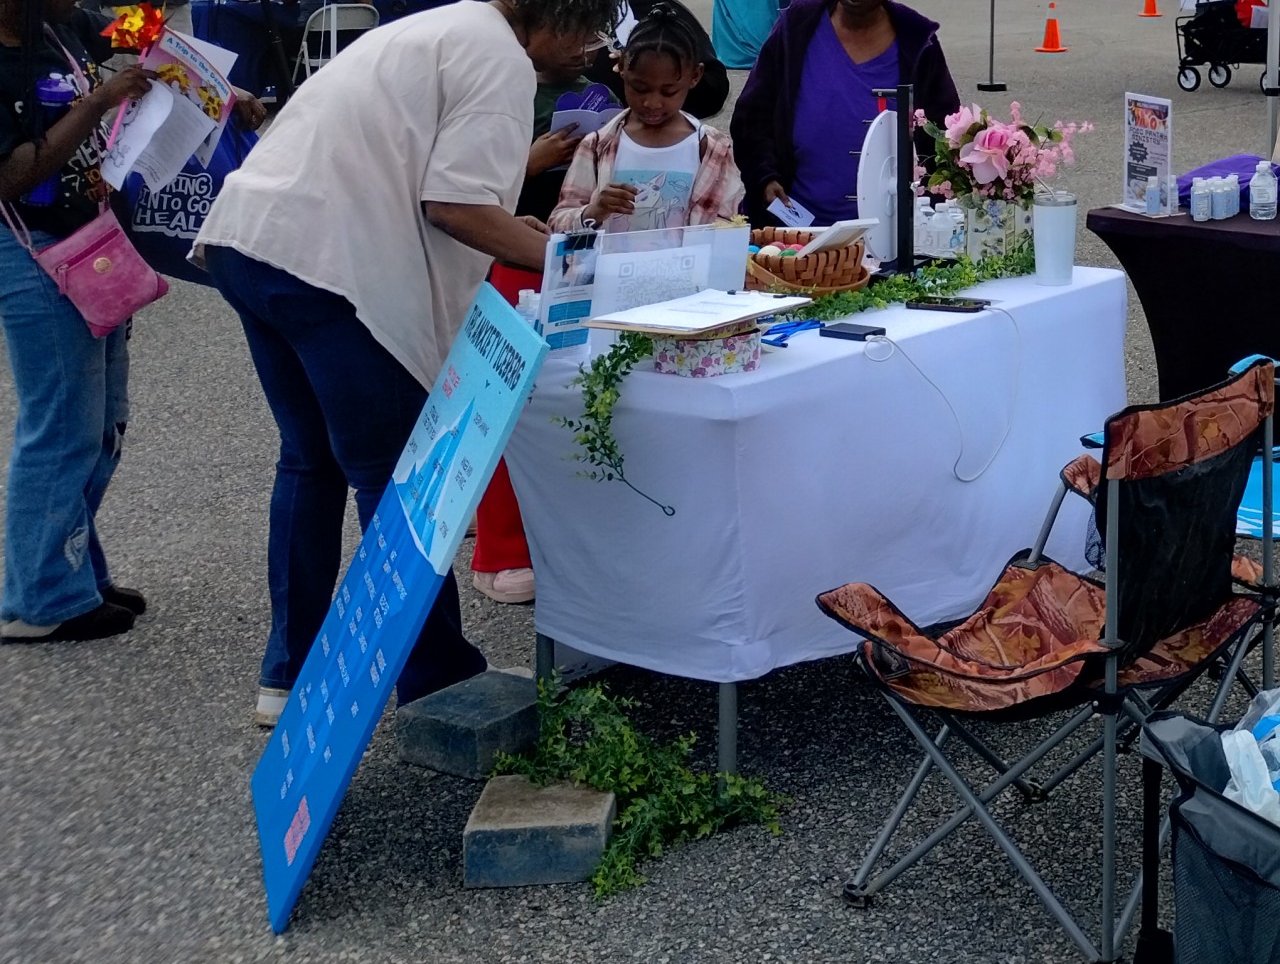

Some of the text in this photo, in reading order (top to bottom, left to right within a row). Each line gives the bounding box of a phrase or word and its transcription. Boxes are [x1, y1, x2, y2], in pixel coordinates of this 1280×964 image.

[175, 41, 189, 55] Trip
[136, 209, 207, 232] HEAL
[469, 312, 503, 367] ANXIETY
[492, 338, 527, 394] ICEBERG
